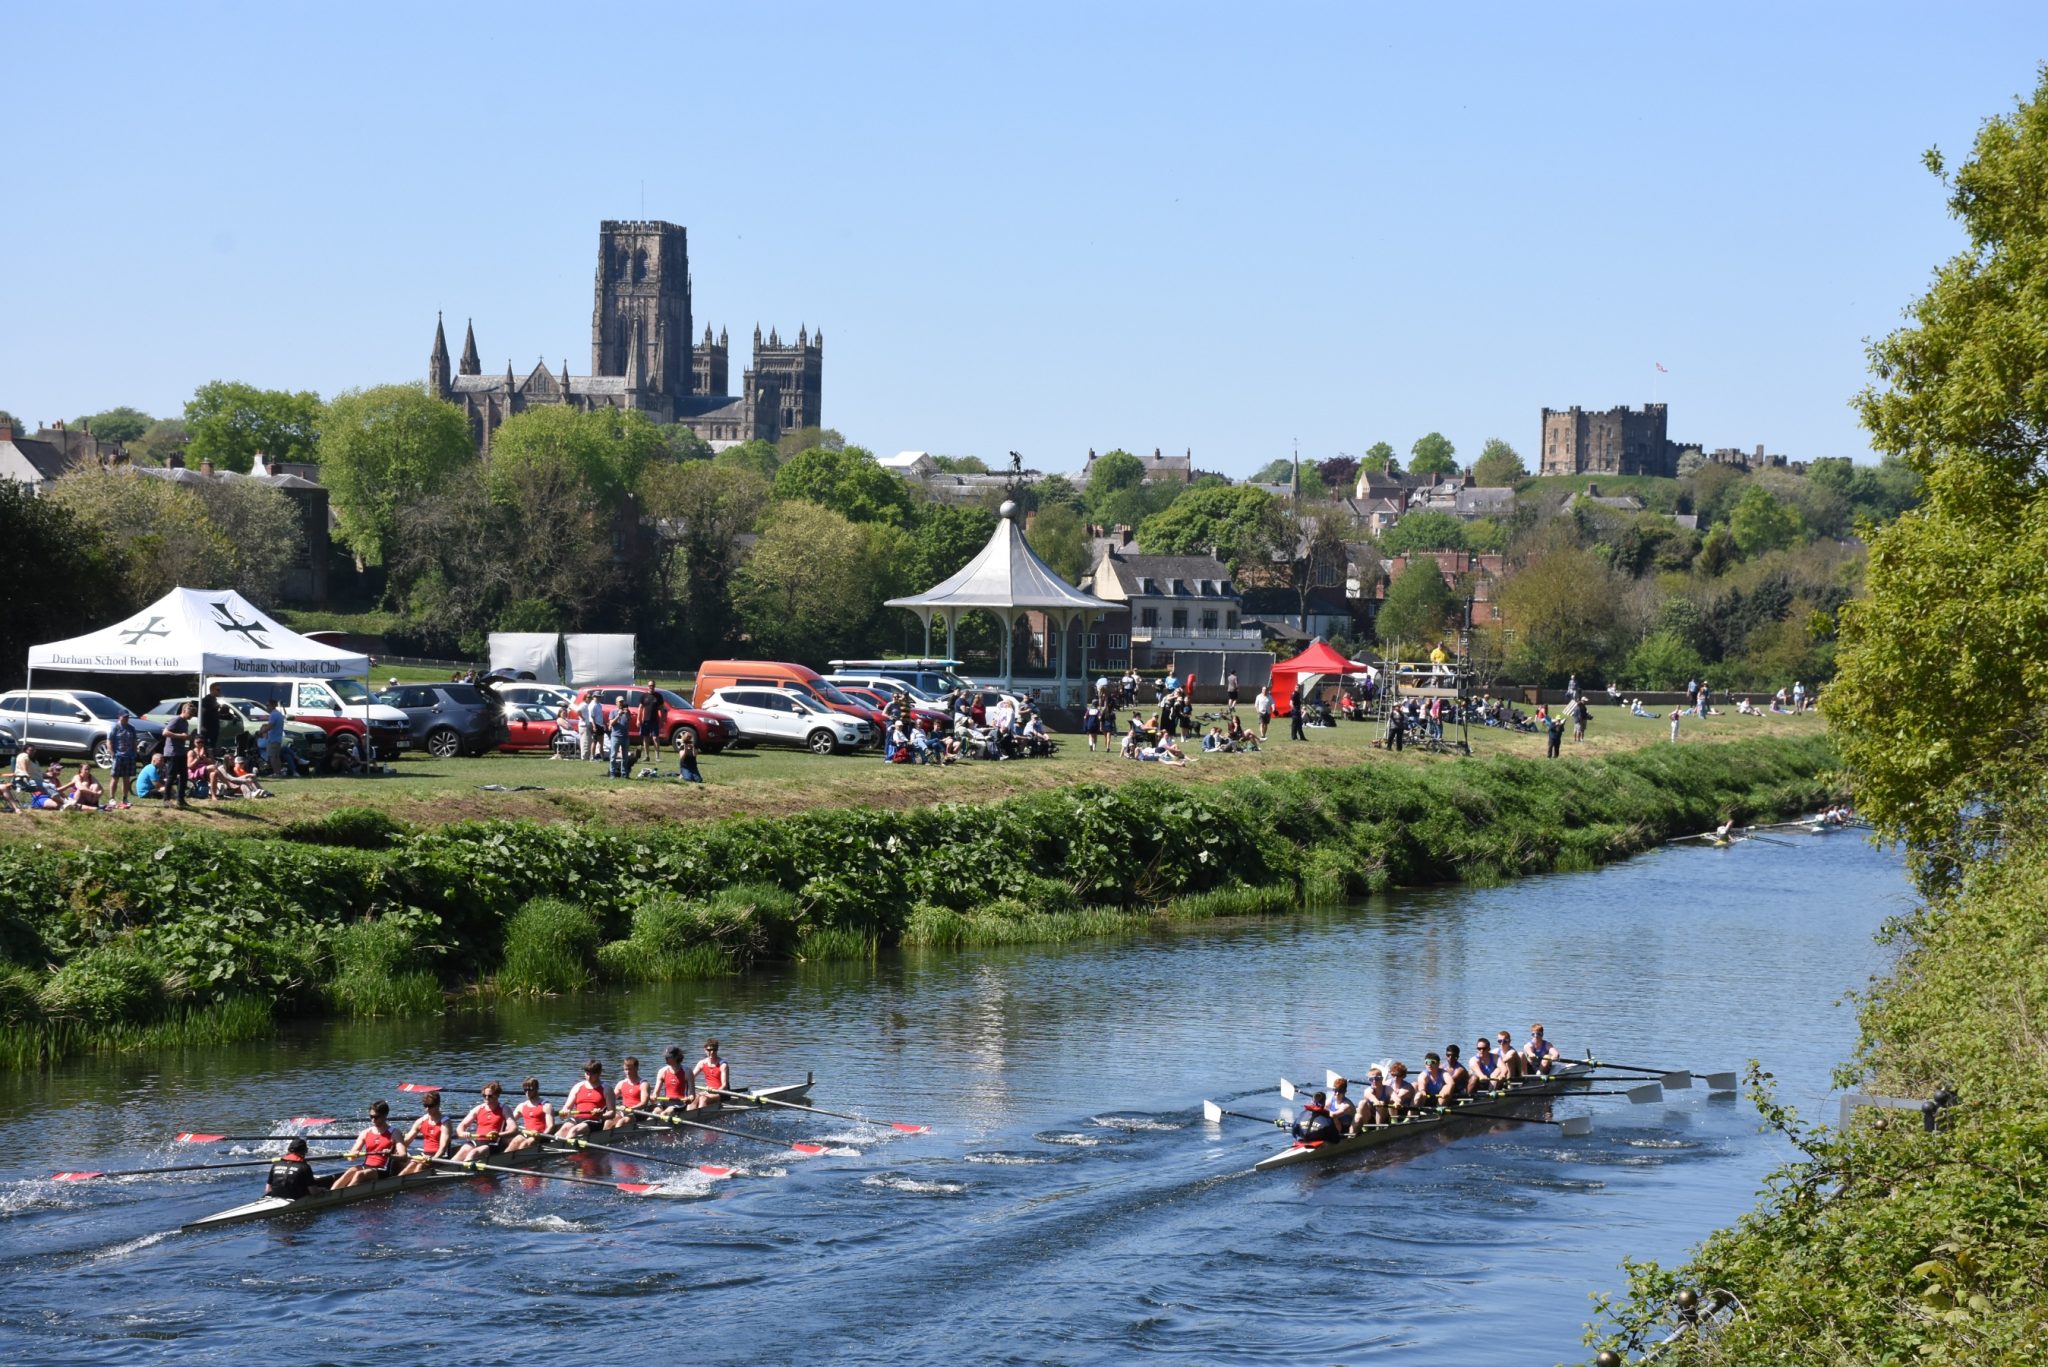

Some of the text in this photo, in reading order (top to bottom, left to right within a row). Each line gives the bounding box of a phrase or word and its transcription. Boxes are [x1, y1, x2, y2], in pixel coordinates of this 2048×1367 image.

[233, 611, 246, 620] S
[52, 653, 179, 667] Durham School Boat Club
[233, 658, 341, 673] Durham School Boat Club
